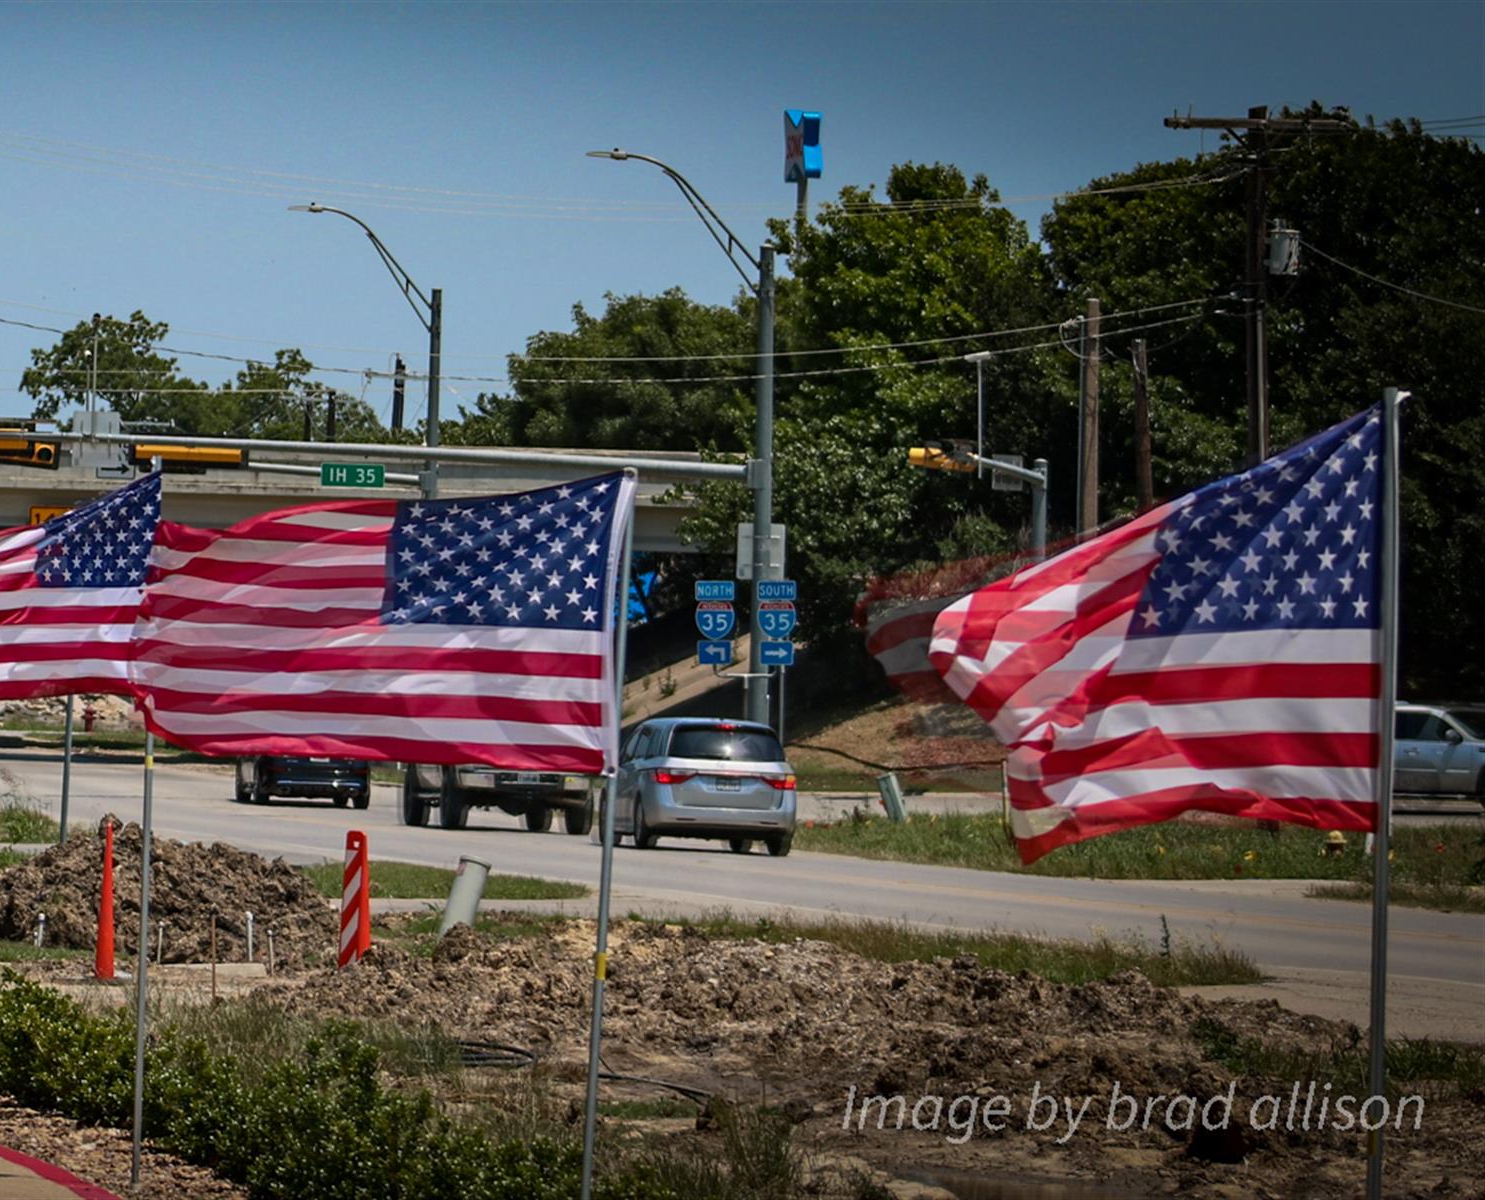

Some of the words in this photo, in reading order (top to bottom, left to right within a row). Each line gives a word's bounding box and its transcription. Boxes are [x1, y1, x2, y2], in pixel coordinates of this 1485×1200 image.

[329, 467, 347, 482] IH
[356, 468, 376, 484] 35
[698, 585, 732, 597] NORTH
[759, 585, 794, 597] SOUTH
[702, 613, 728, 631] 35
[764, 613, 790, 631] 35
